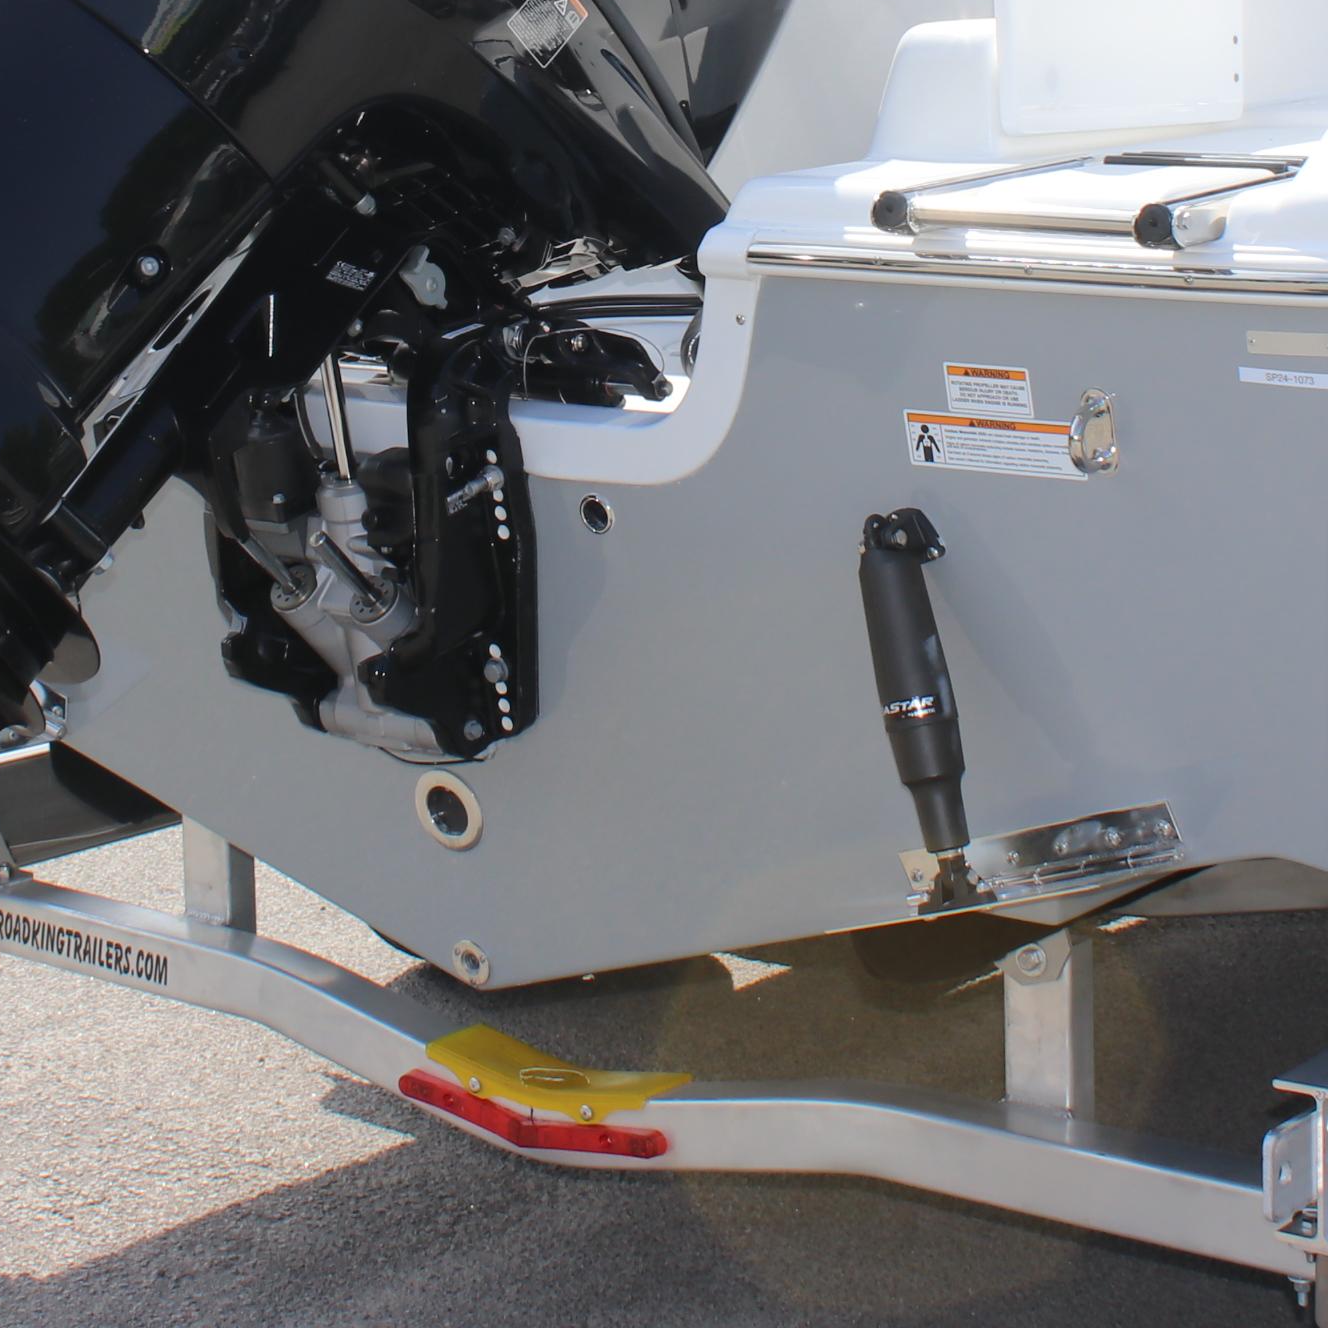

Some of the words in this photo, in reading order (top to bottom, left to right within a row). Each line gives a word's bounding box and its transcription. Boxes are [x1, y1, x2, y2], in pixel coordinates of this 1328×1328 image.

[971, 368, 1010, 378] WARNING
[1265, 373, 1315, 385] SP24-1073
[976, 420, 1016, 430] WARNING
[881, 696, 934, 715] ASTAR
